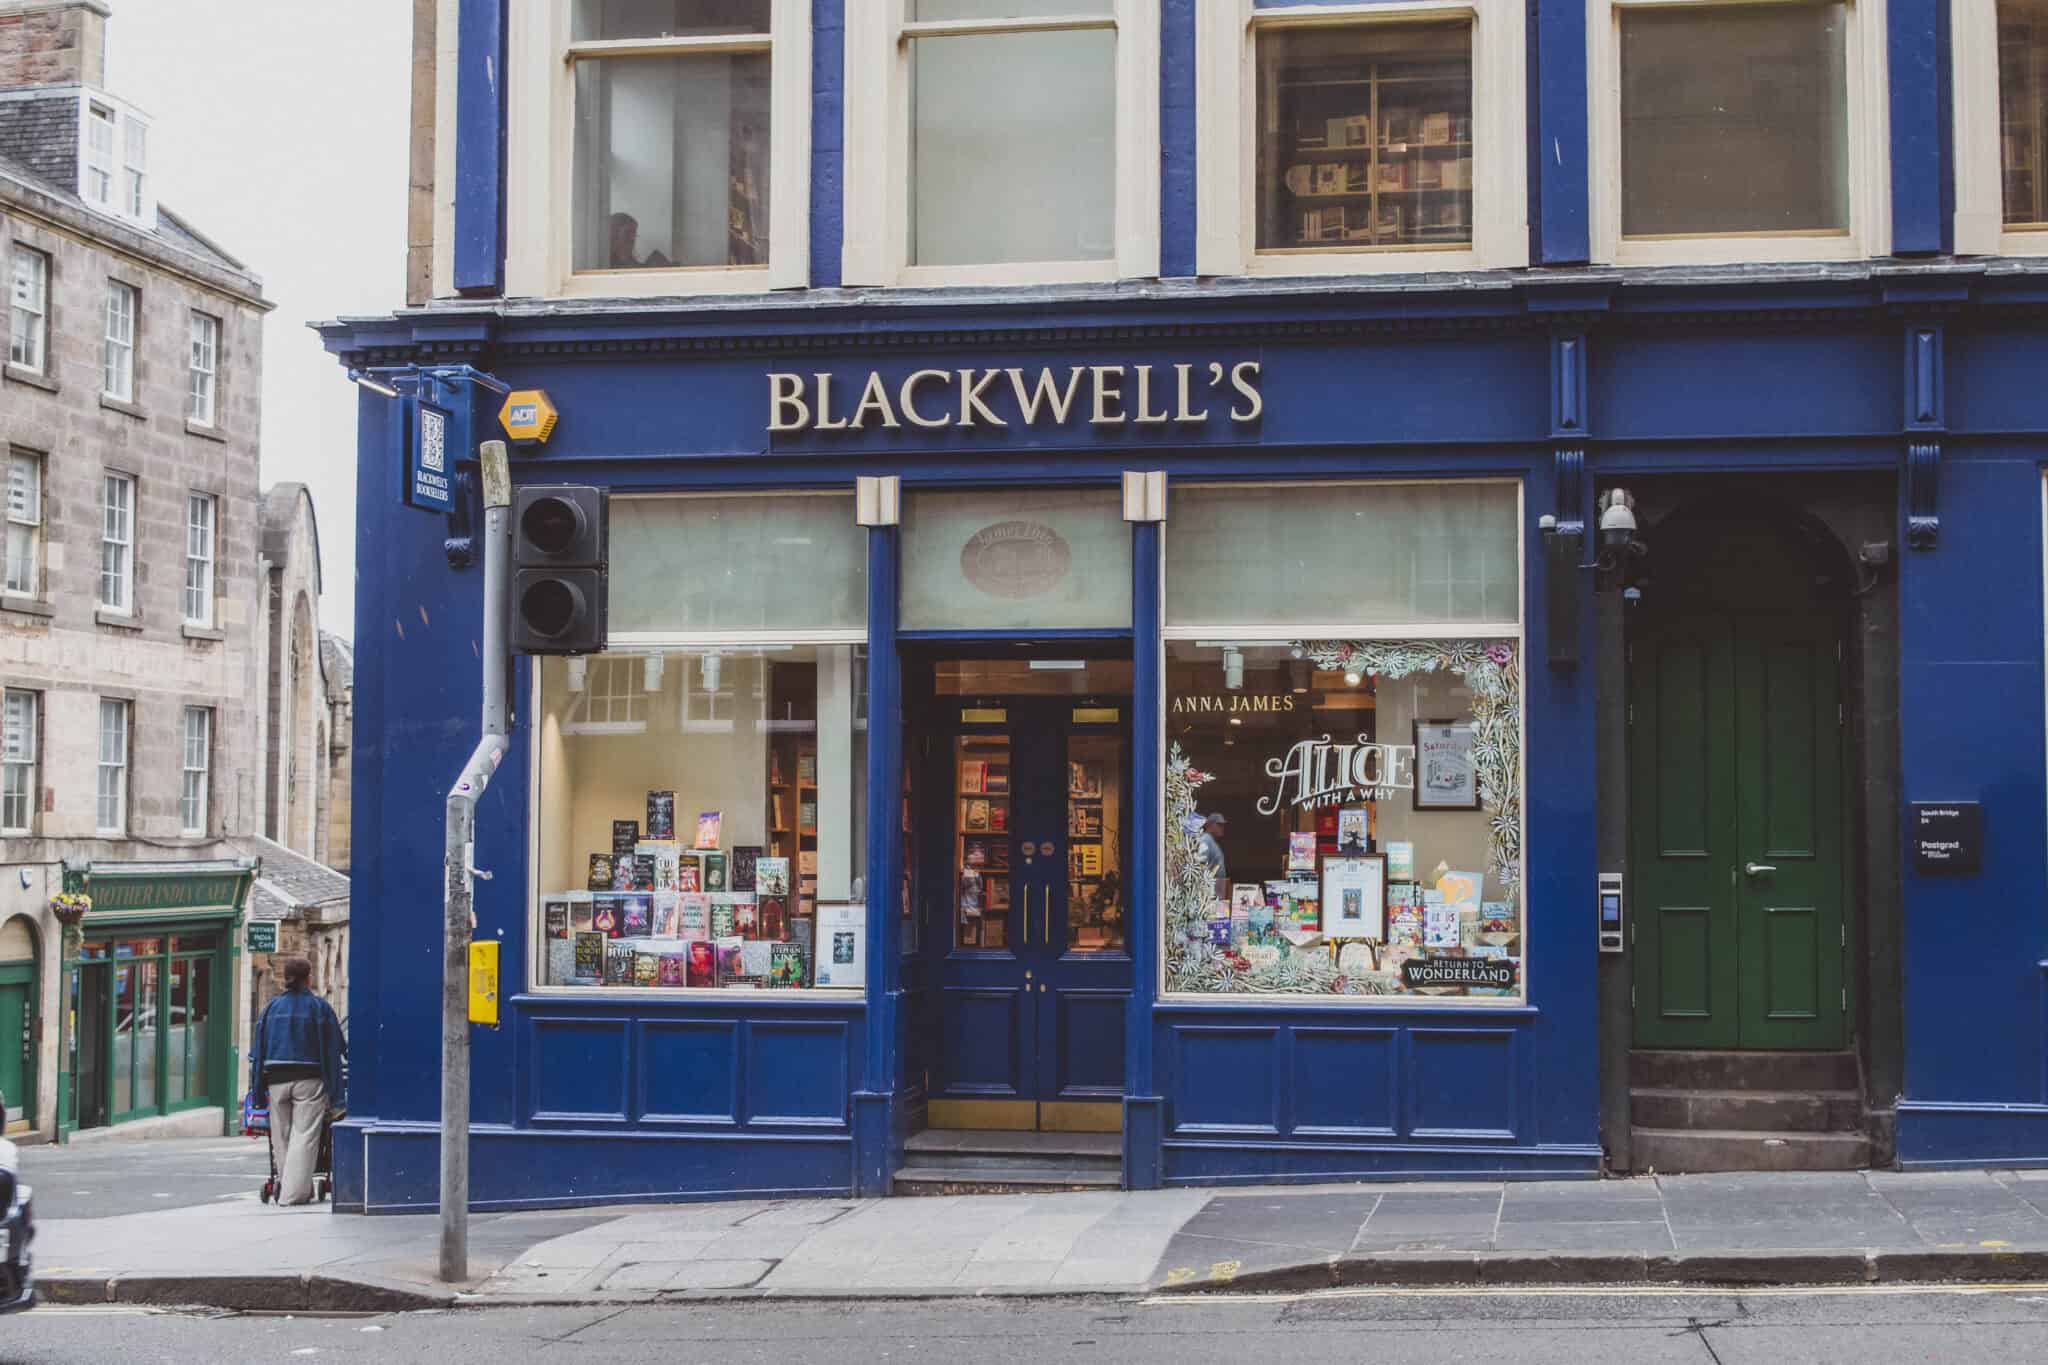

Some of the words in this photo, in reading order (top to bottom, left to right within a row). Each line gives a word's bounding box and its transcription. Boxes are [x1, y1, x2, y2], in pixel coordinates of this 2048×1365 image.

[766, 362, 1263, 431] BLACKWELL'S
[511, 408, 536, 422] ADT
[416, 483, 448, 501] BOOKSELLERS
[1173, 696, 1224, 713] ANNA
[1230, 695, 1294, 712] JAMES
[1257, 733, 1416, 816] ALICE
[1302, 790, 1342, 812] WITH
[1346, 790, 1356, 801] A
[1360, 787, 1396, 801] WHY
[1921, 841, 1959, 849] Postgrad
[773, 953, 798, 962] KING
[1433, 959, 1471, 969] RETURN
[1472, 960, 1484, 969] TO
[1408, 967, 1510, 982] WONDERLAND
